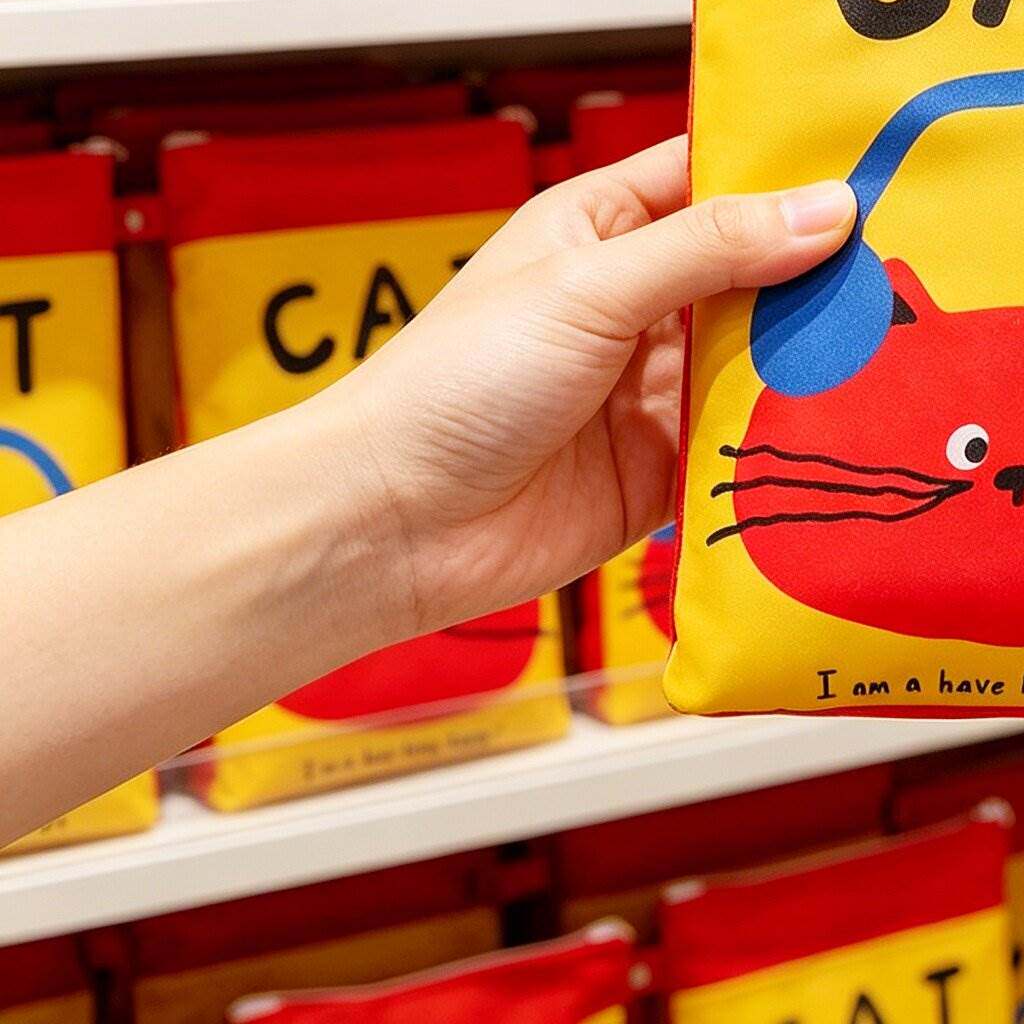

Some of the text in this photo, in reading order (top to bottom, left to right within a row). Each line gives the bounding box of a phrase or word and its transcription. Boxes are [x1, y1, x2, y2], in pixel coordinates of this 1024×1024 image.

[262, 254, 474, 375] CA
[817, 669, 837, 700] I
[853, 681, 890, 696] am
[906, 678, 921, 692] a
[939, 669, 1004, 695] have
